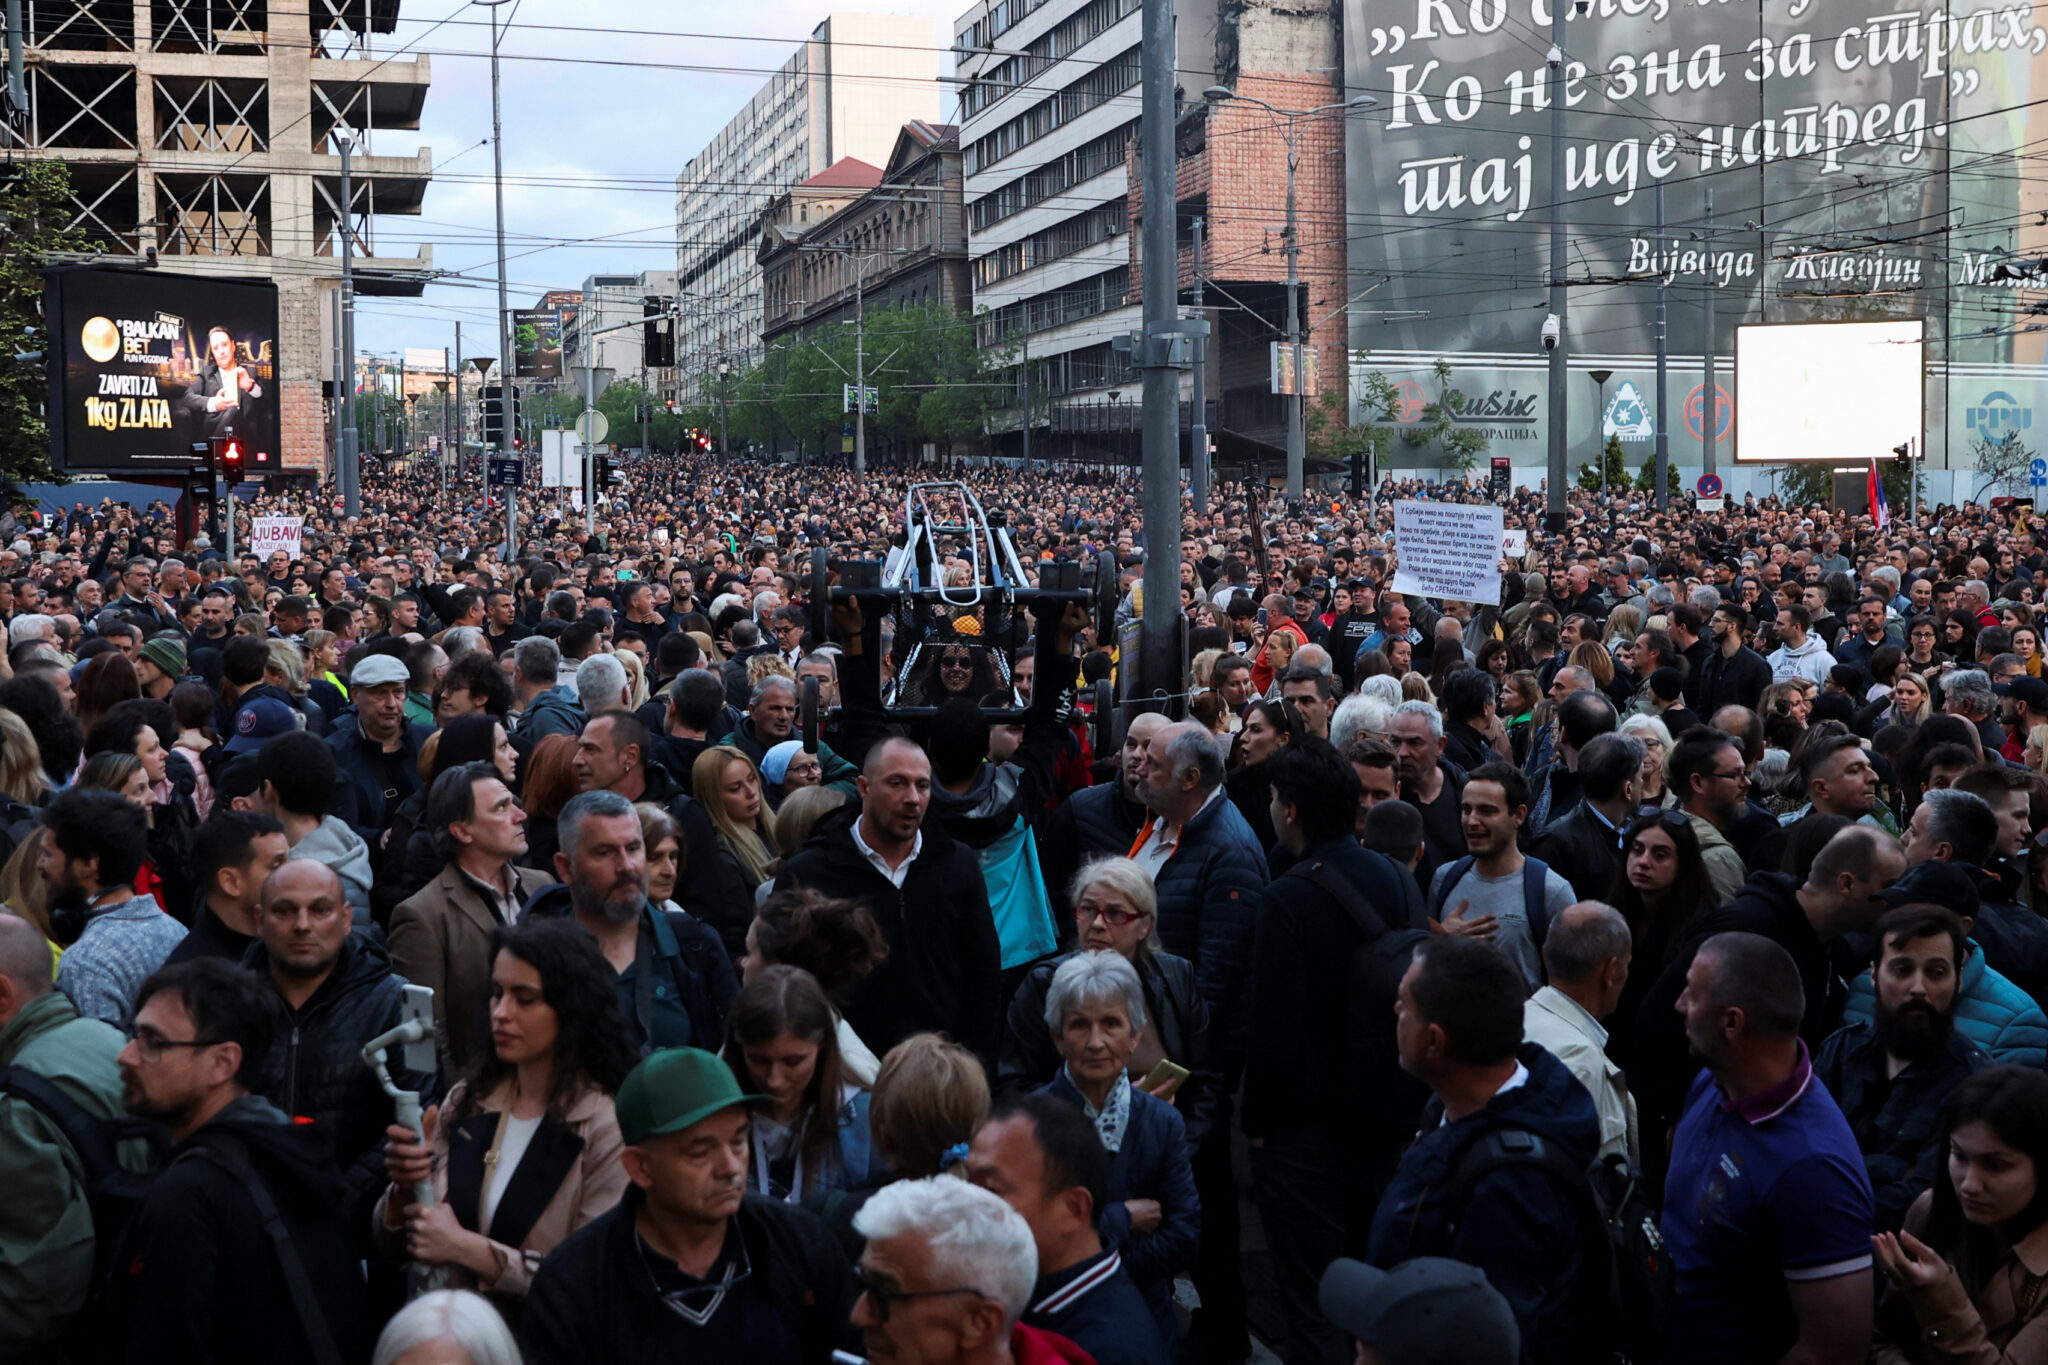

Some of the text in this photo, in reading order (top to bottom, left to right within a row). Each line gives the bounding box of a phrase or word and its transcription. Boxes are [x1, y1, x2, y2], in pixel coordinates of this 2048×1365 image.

[1386, 4, 2047, 130] Ко не зна за страх,
[1398, 136, 1532, 221] тај
[1566, 133, 1678, 206] иде
[1627, 238, 1755, 287] Војвода
[1784, 245, 1923, 290] Живојин
[123, 320, 179, 340] BALKAN
[124, 337, 151, 354] BET
[124, 354, 138, 363] PUN
[99, 374, 158, 396] ZAVRTI ZA
[84, 396, 172, 431] 1kg ZLATA
[1405, 507, 1423, 516] Србији
[252, 526, 300, 542] LJUBAVI
